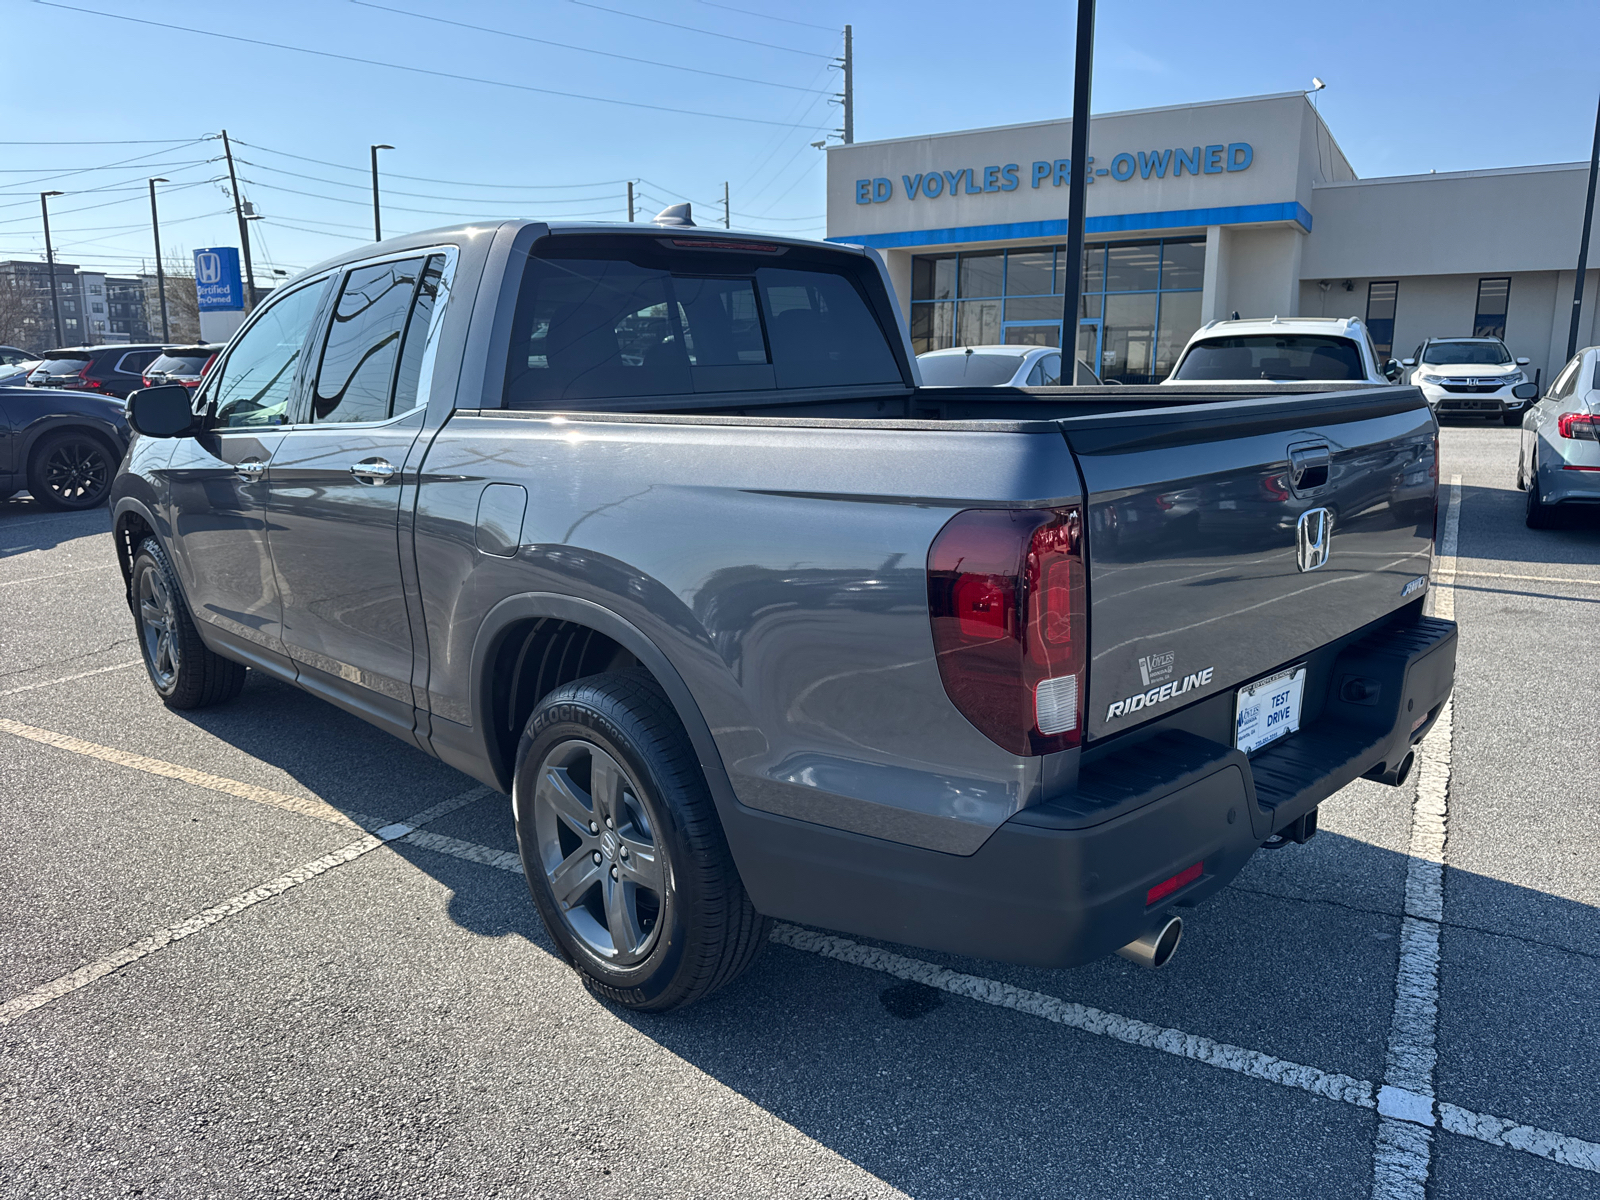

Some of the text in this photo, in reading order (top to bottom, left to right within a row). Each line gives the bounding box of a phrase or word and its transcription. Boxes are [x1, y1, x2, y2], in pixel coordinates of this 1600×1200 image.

[856, 177, 892, 205] ED
[902, 163, 1019, 201] VOYLES
[197, 284, 231, 295] Certified
[1401, 576, 1426, 597] AWD
[1105, 666, 1214, 722] RIDGELINE
[1271, 690, 1291, 709] TEST
[1267, 706, 1291, 727] DRIVE
[526, 704, 632, 752] VELOCITY CROSS
